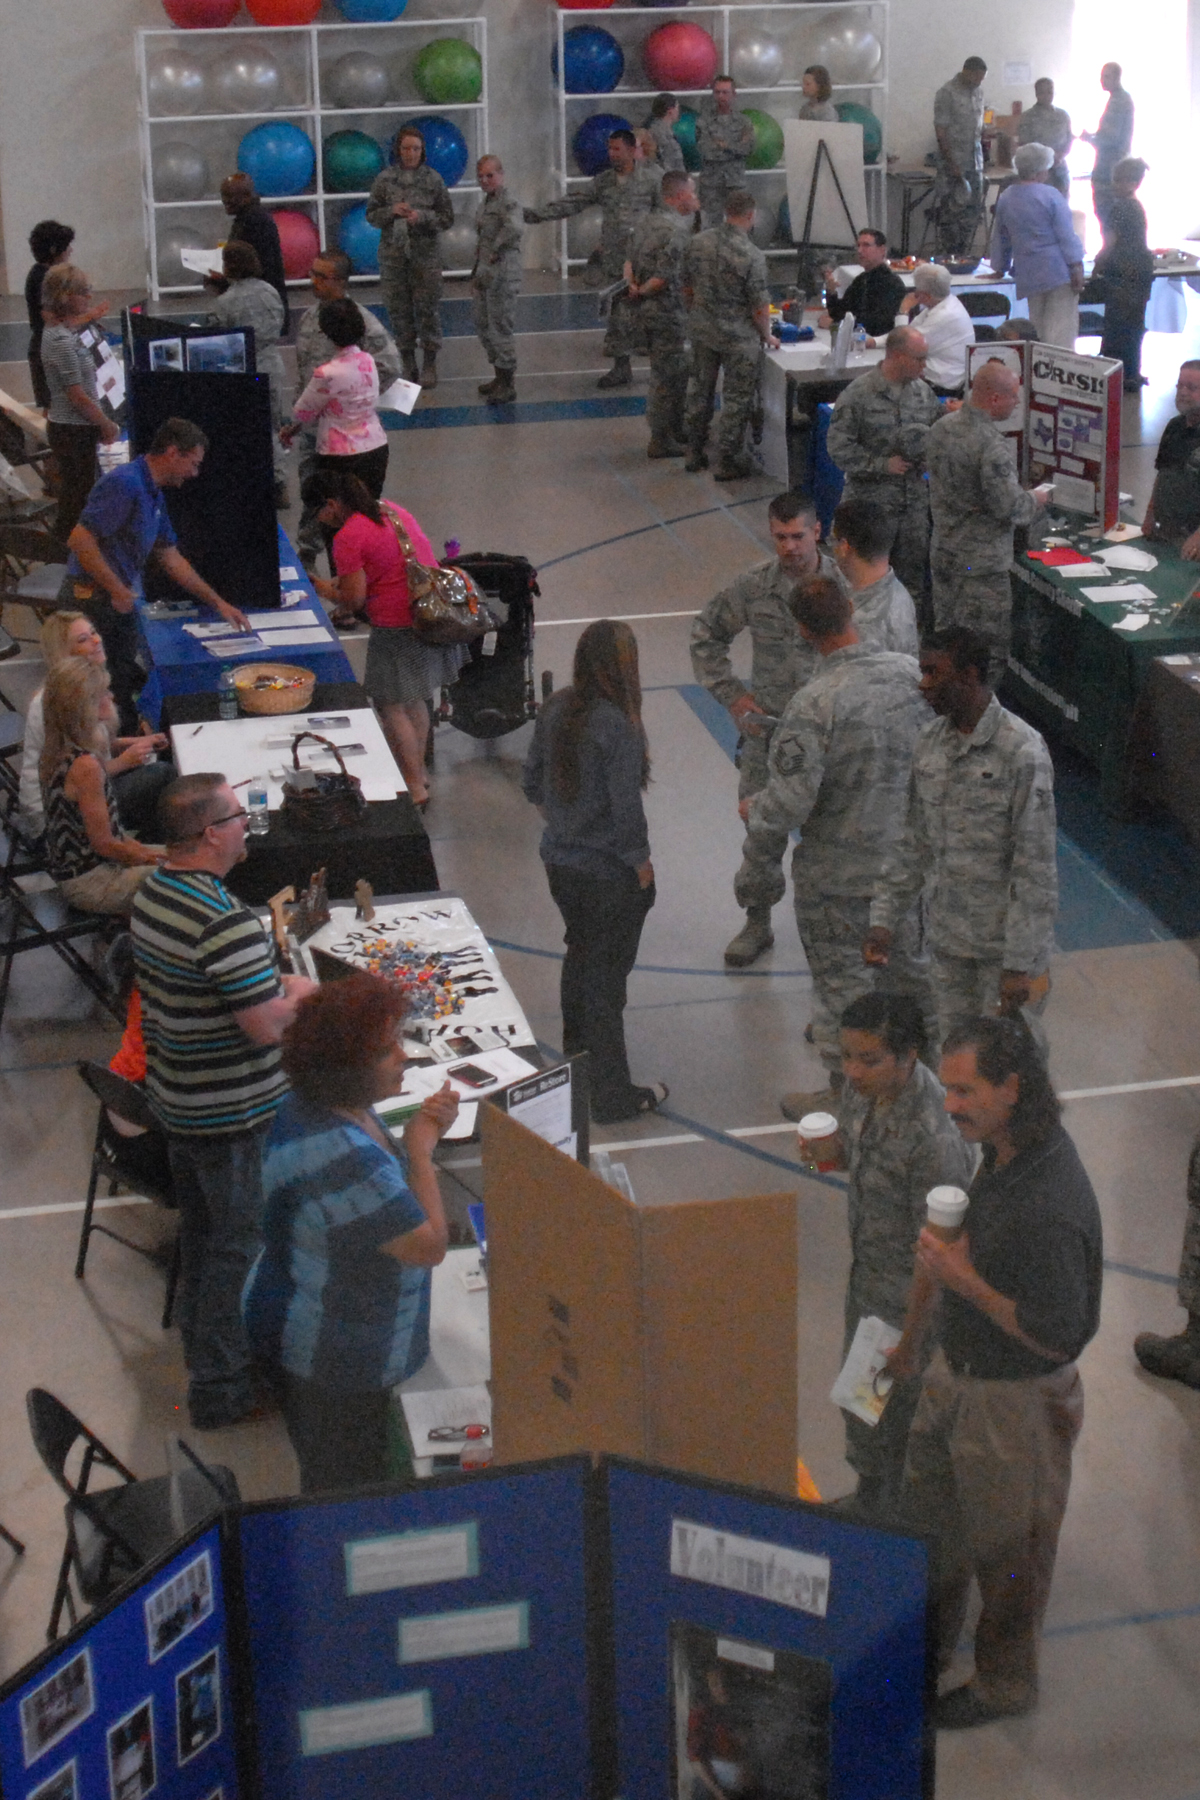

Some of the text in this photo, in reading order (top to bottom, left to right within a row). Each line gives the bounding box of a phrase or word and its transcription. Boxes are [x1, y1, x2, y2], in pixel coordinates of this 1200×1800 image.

[330, 909, 452, 957] ORROW
[424, 1024, 517, 1047] HOP
[675, 1526, 827, 1612] Volunteer
